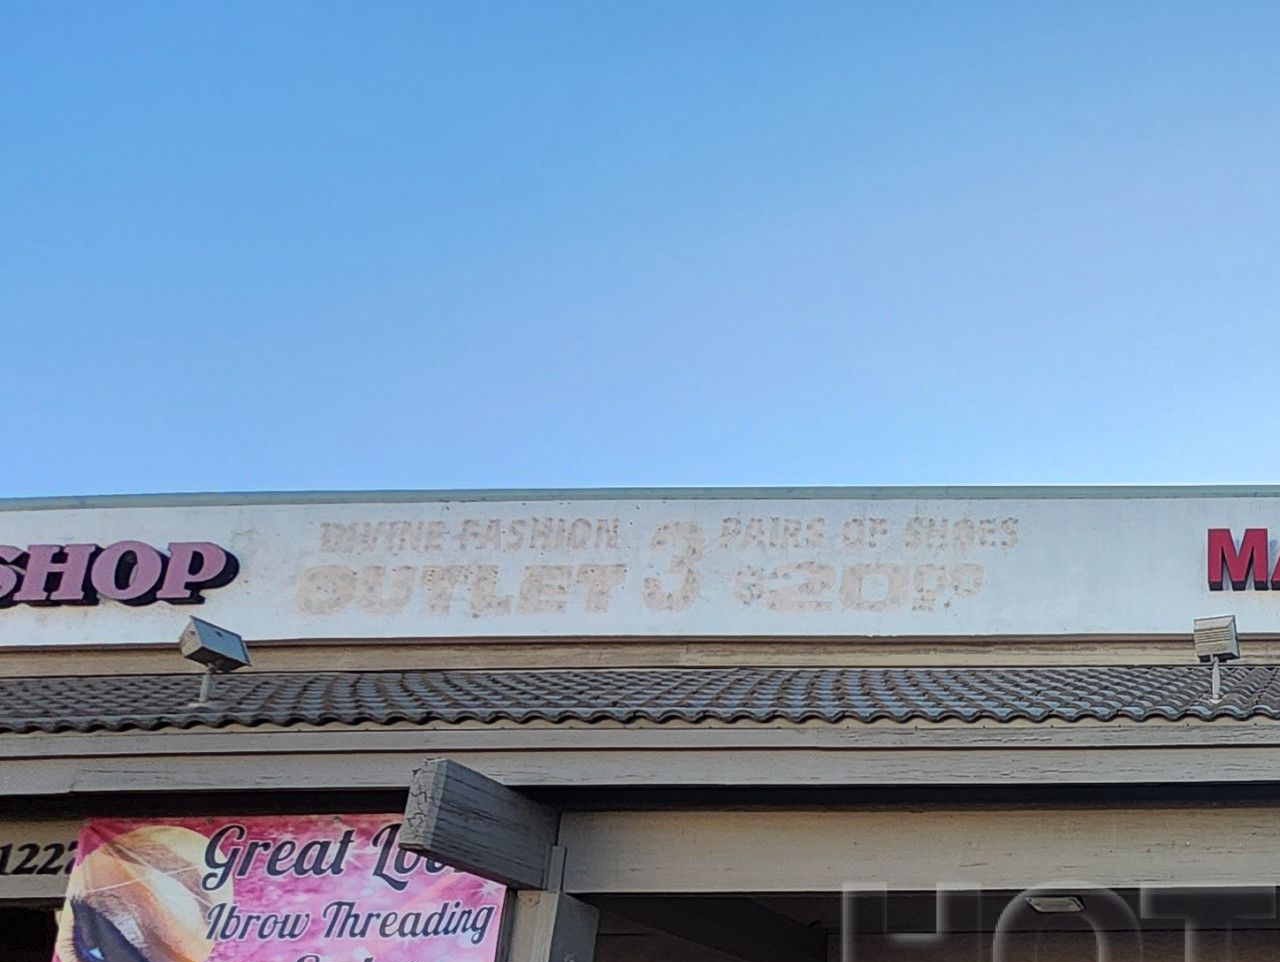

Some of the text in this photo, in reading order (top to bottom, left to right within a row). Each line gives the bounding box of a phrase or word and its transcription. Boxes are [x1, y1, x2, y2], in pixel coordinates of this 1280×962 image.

[201, 823, 462, 891] Great Lo
[205, 901, 495, 945] Ibrow Threading
